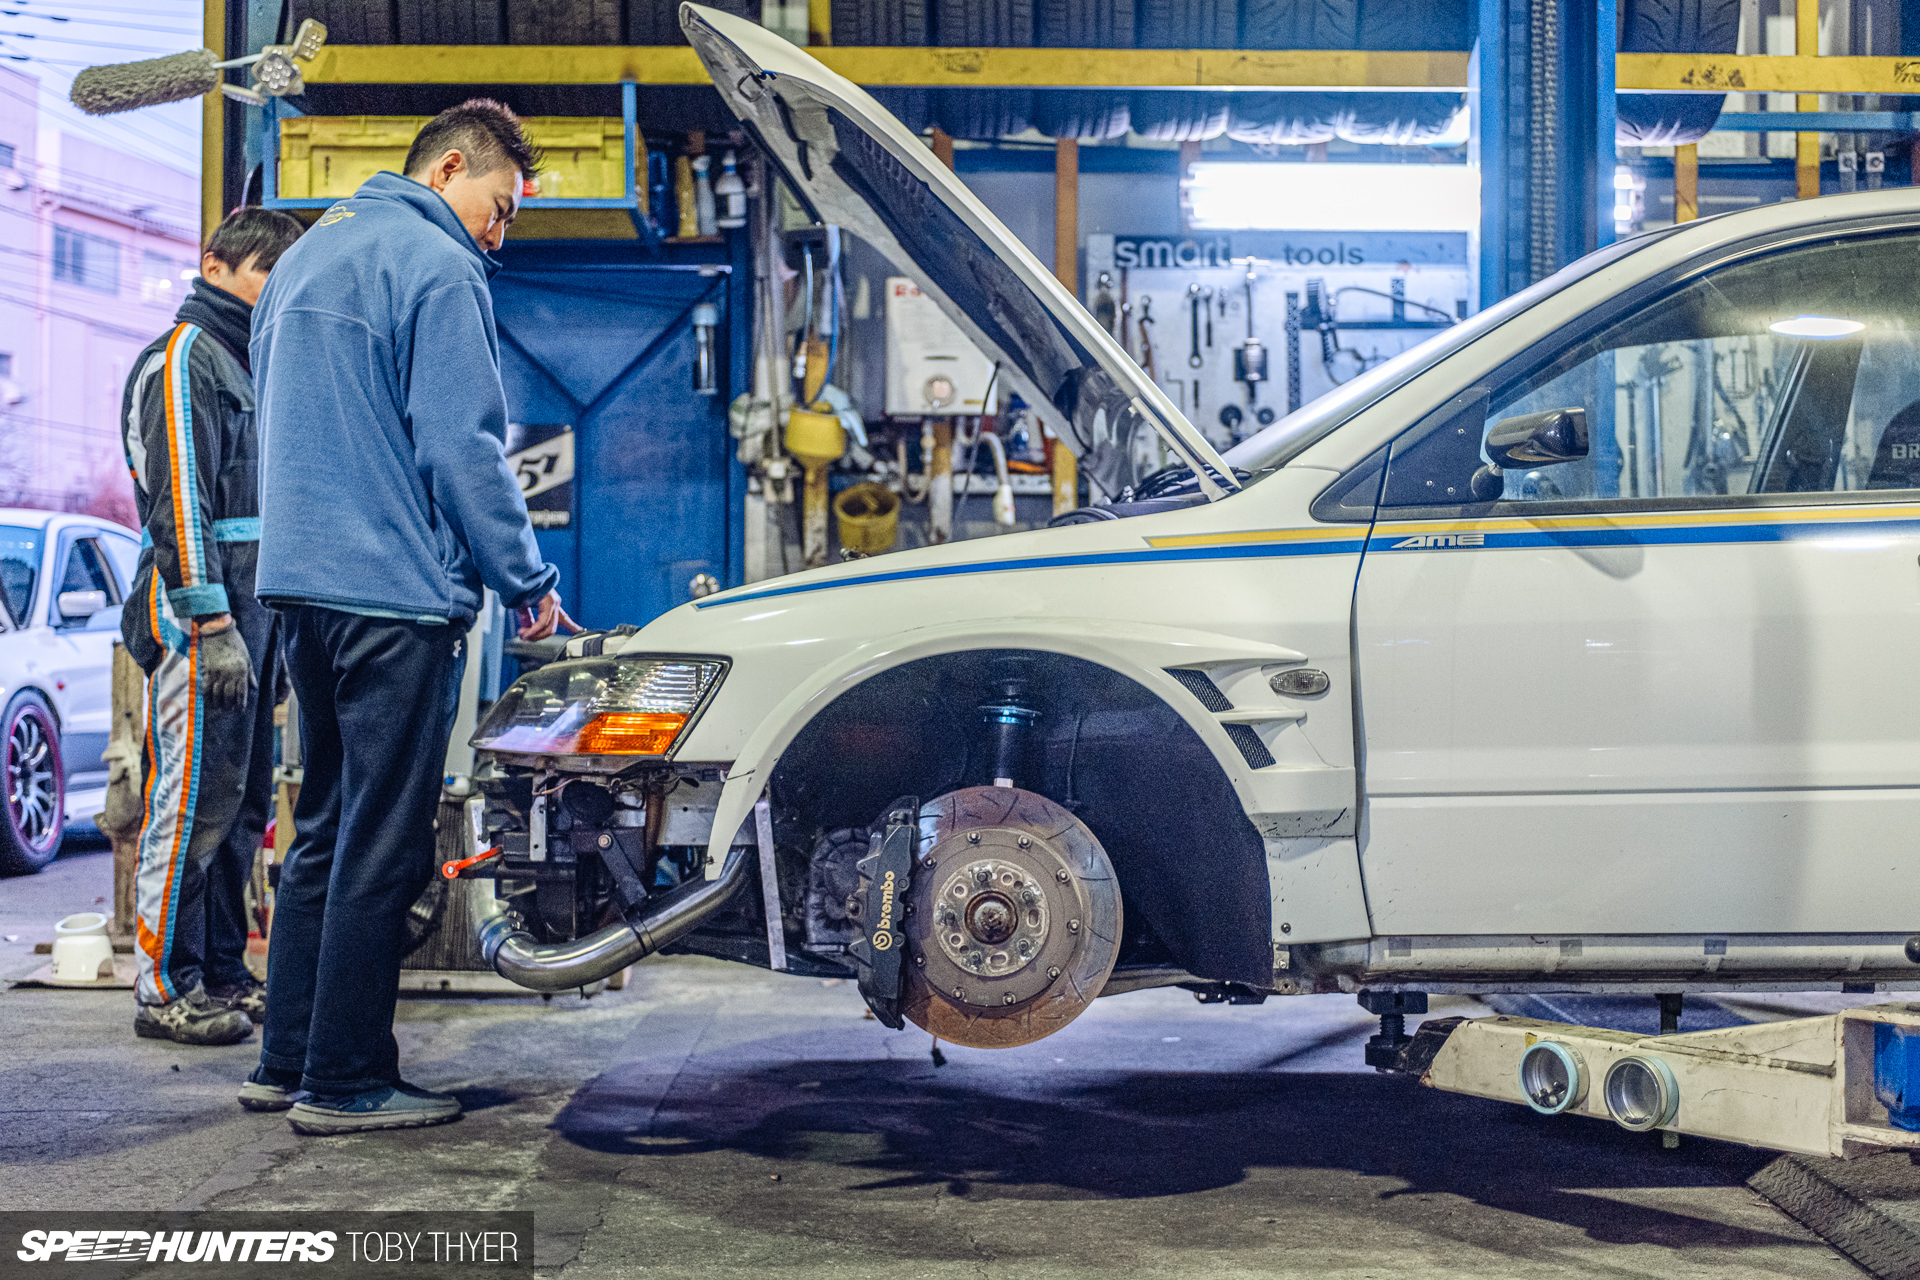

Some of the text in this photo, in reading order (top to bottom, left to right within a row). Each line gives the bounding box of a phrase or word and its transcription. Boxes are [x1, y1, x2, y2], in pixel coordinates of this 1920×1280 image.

[1115, 236, 1365, 268] smart tools
[1391, 533, 1484, 548] AME
[877, 871, 895, 929] brembo
